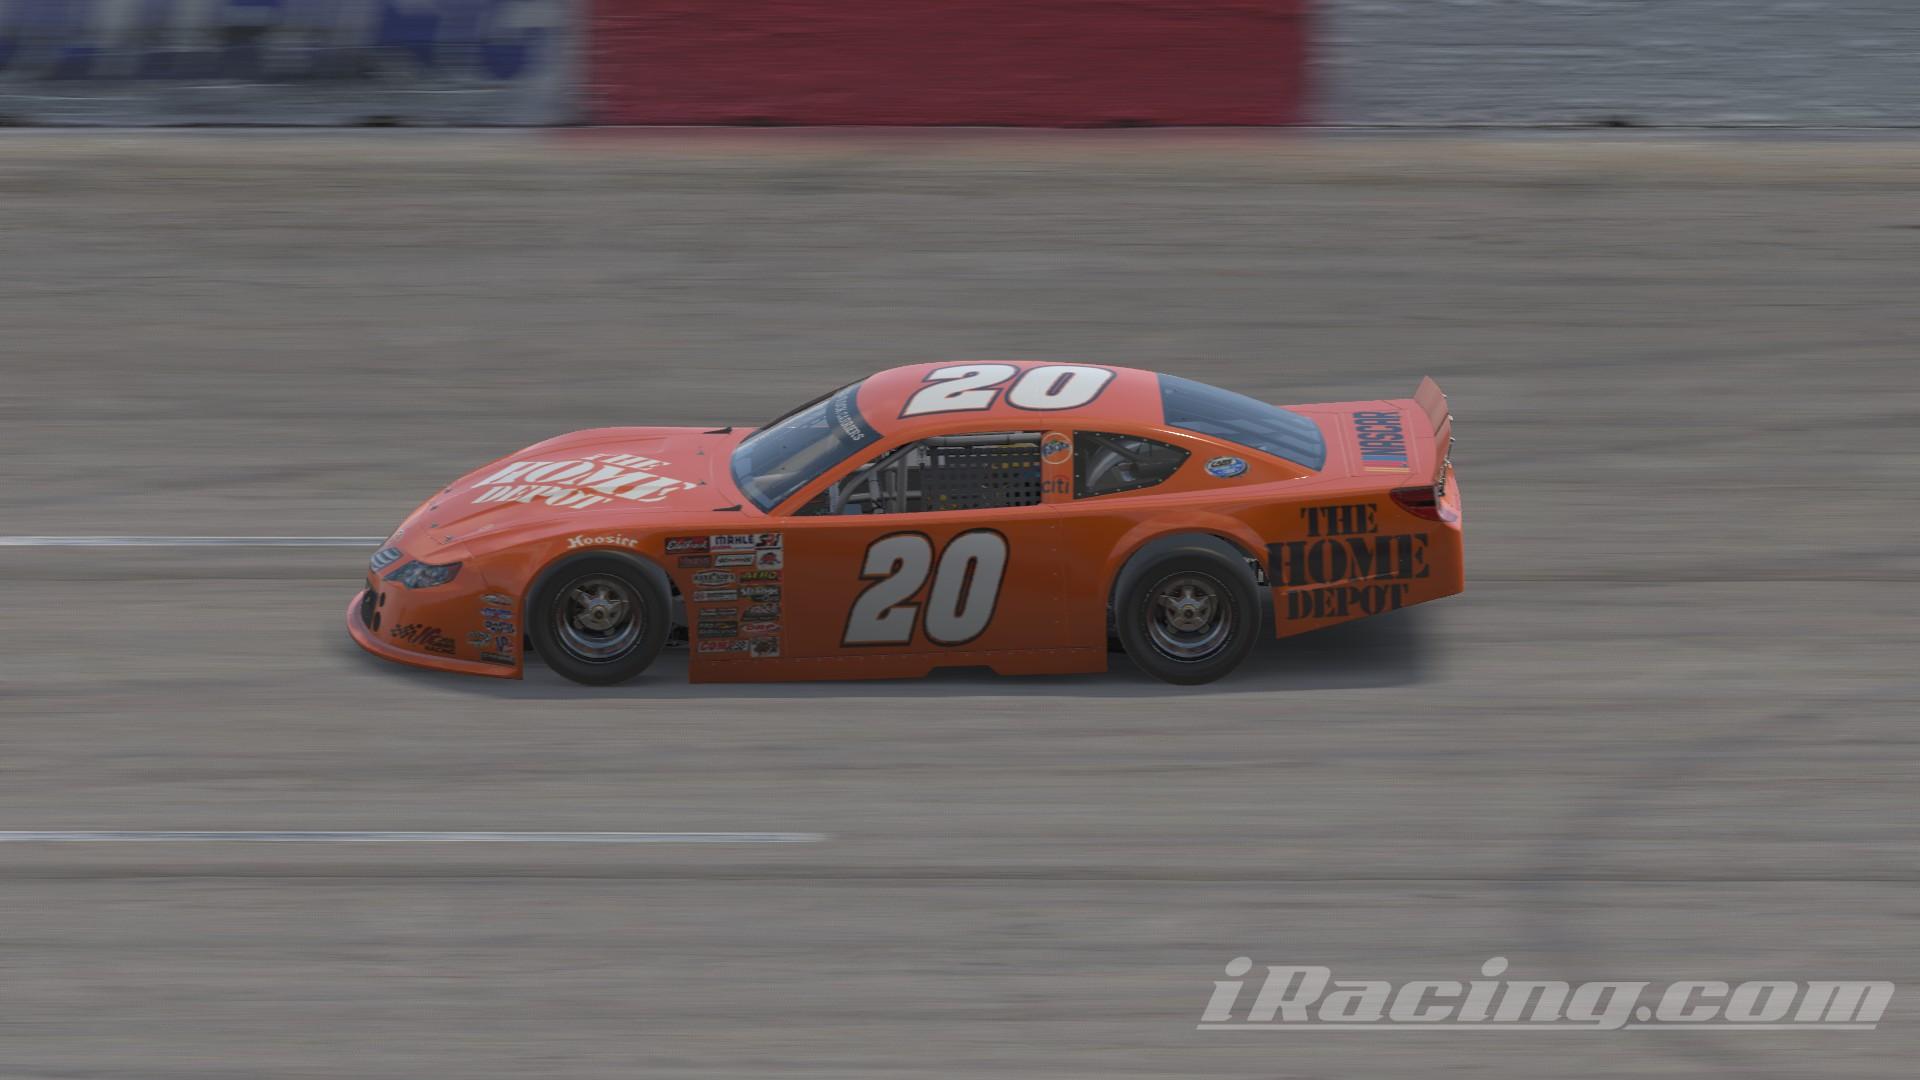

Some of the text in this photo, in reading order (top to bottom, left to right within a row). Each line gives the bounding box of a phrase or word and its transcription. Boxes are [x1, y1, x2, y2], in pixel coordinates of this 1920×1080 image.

[898, 363, 1117, 419] 20
[1352, 411, 1408, 456] NASCAR
[471, 460, 697, 502] HOME
[581, 453, 672, 470] THE
[471, 485, 614, 509] DEPOT
[1301, 504, 1377, 537] THE
[567, 533, 639, 549] Hoosier
[1265, 533, 1430, 587] HOME
[840, 528, 1010, 648] 20
[1286, 584, 1409, 620] DEPOT
